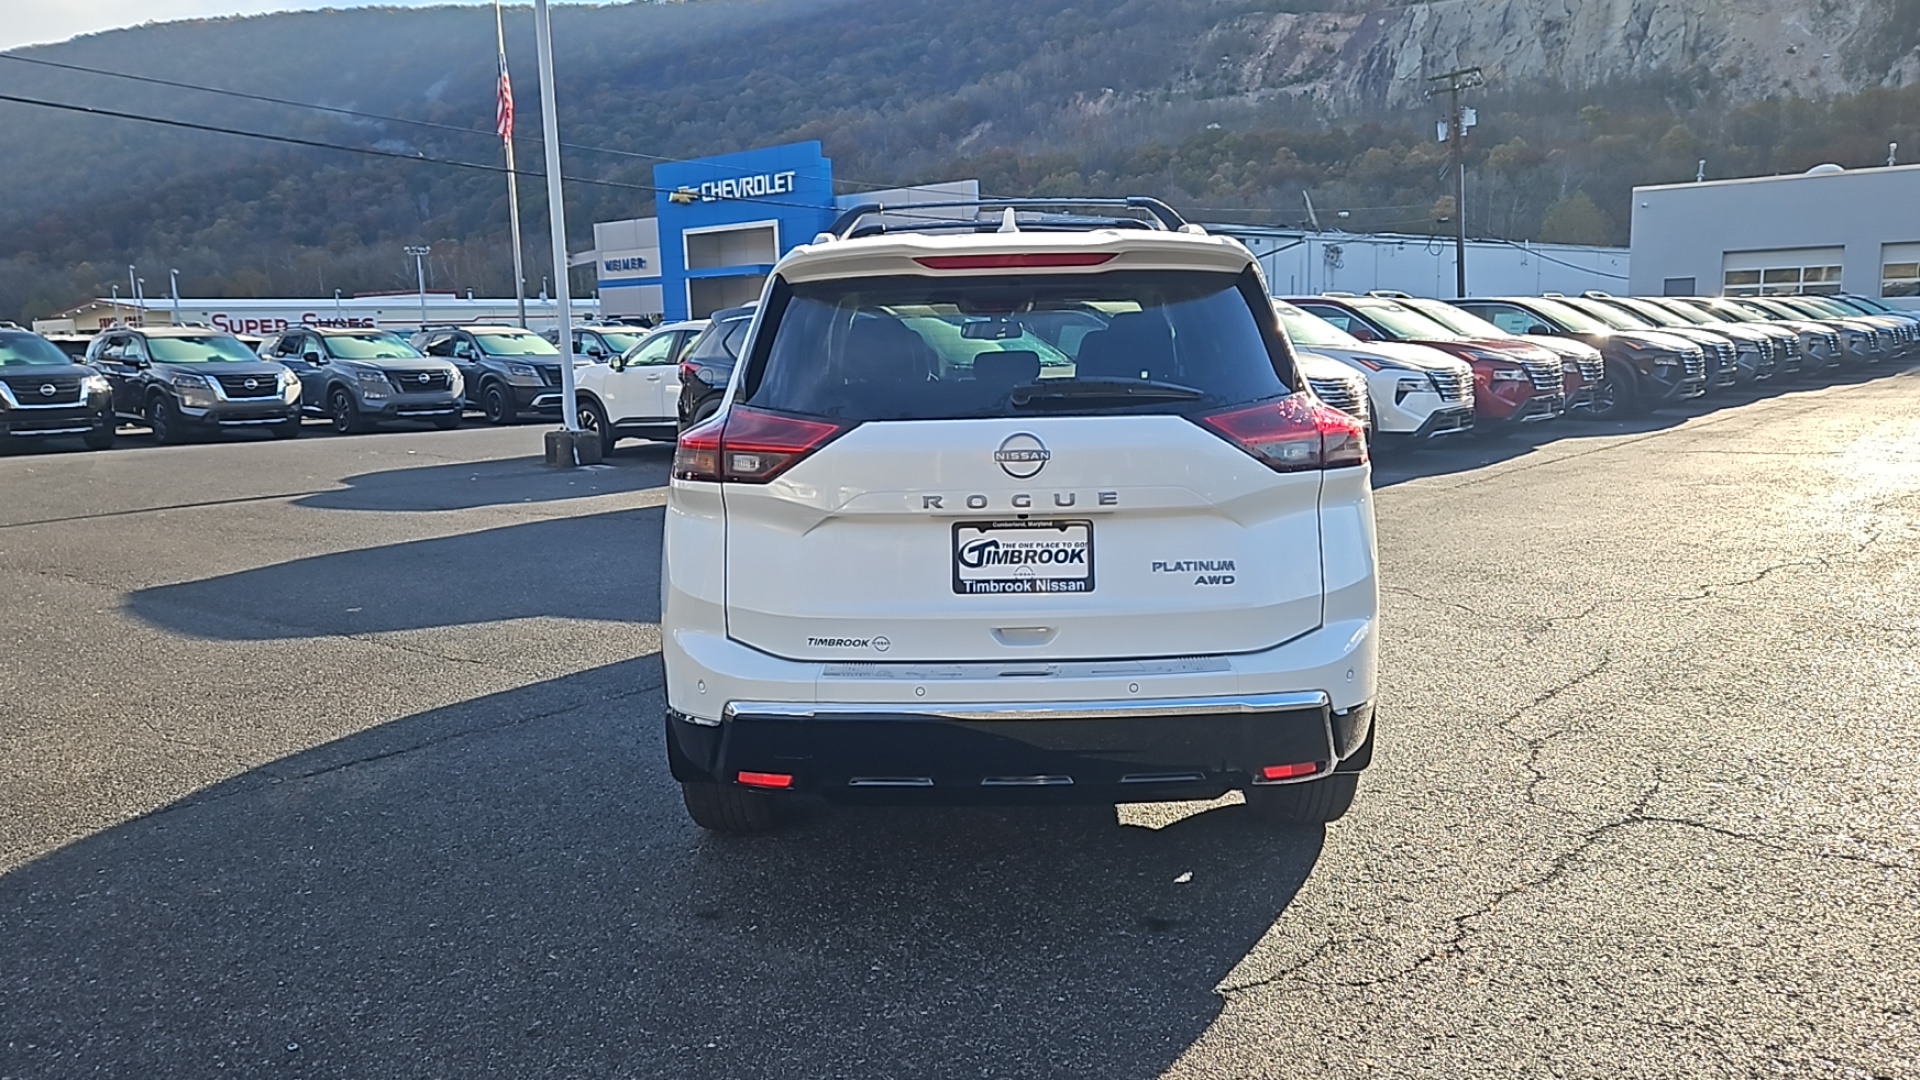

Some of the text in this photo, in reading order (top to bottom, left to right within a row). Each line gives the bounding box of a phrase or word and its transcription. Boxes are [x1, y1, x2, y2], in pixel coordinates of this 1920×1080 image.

[701, 171, 796, 202] CHEVROLET
[212, 314, 288, 334] SUPER
[995, 450, 1049, 461] NISSAN
[922, 491, 1118, 509] ROGUE
[960, 539, 1086, 568] TIMBROOK
[1152, 560, 1236, 572] PLATINUM
[963, 580, 1085, 593] Timbrook Nissan
[1194, 575, 1236, 585] AWD
[808, 637, 870, 648] TIMBROOK
